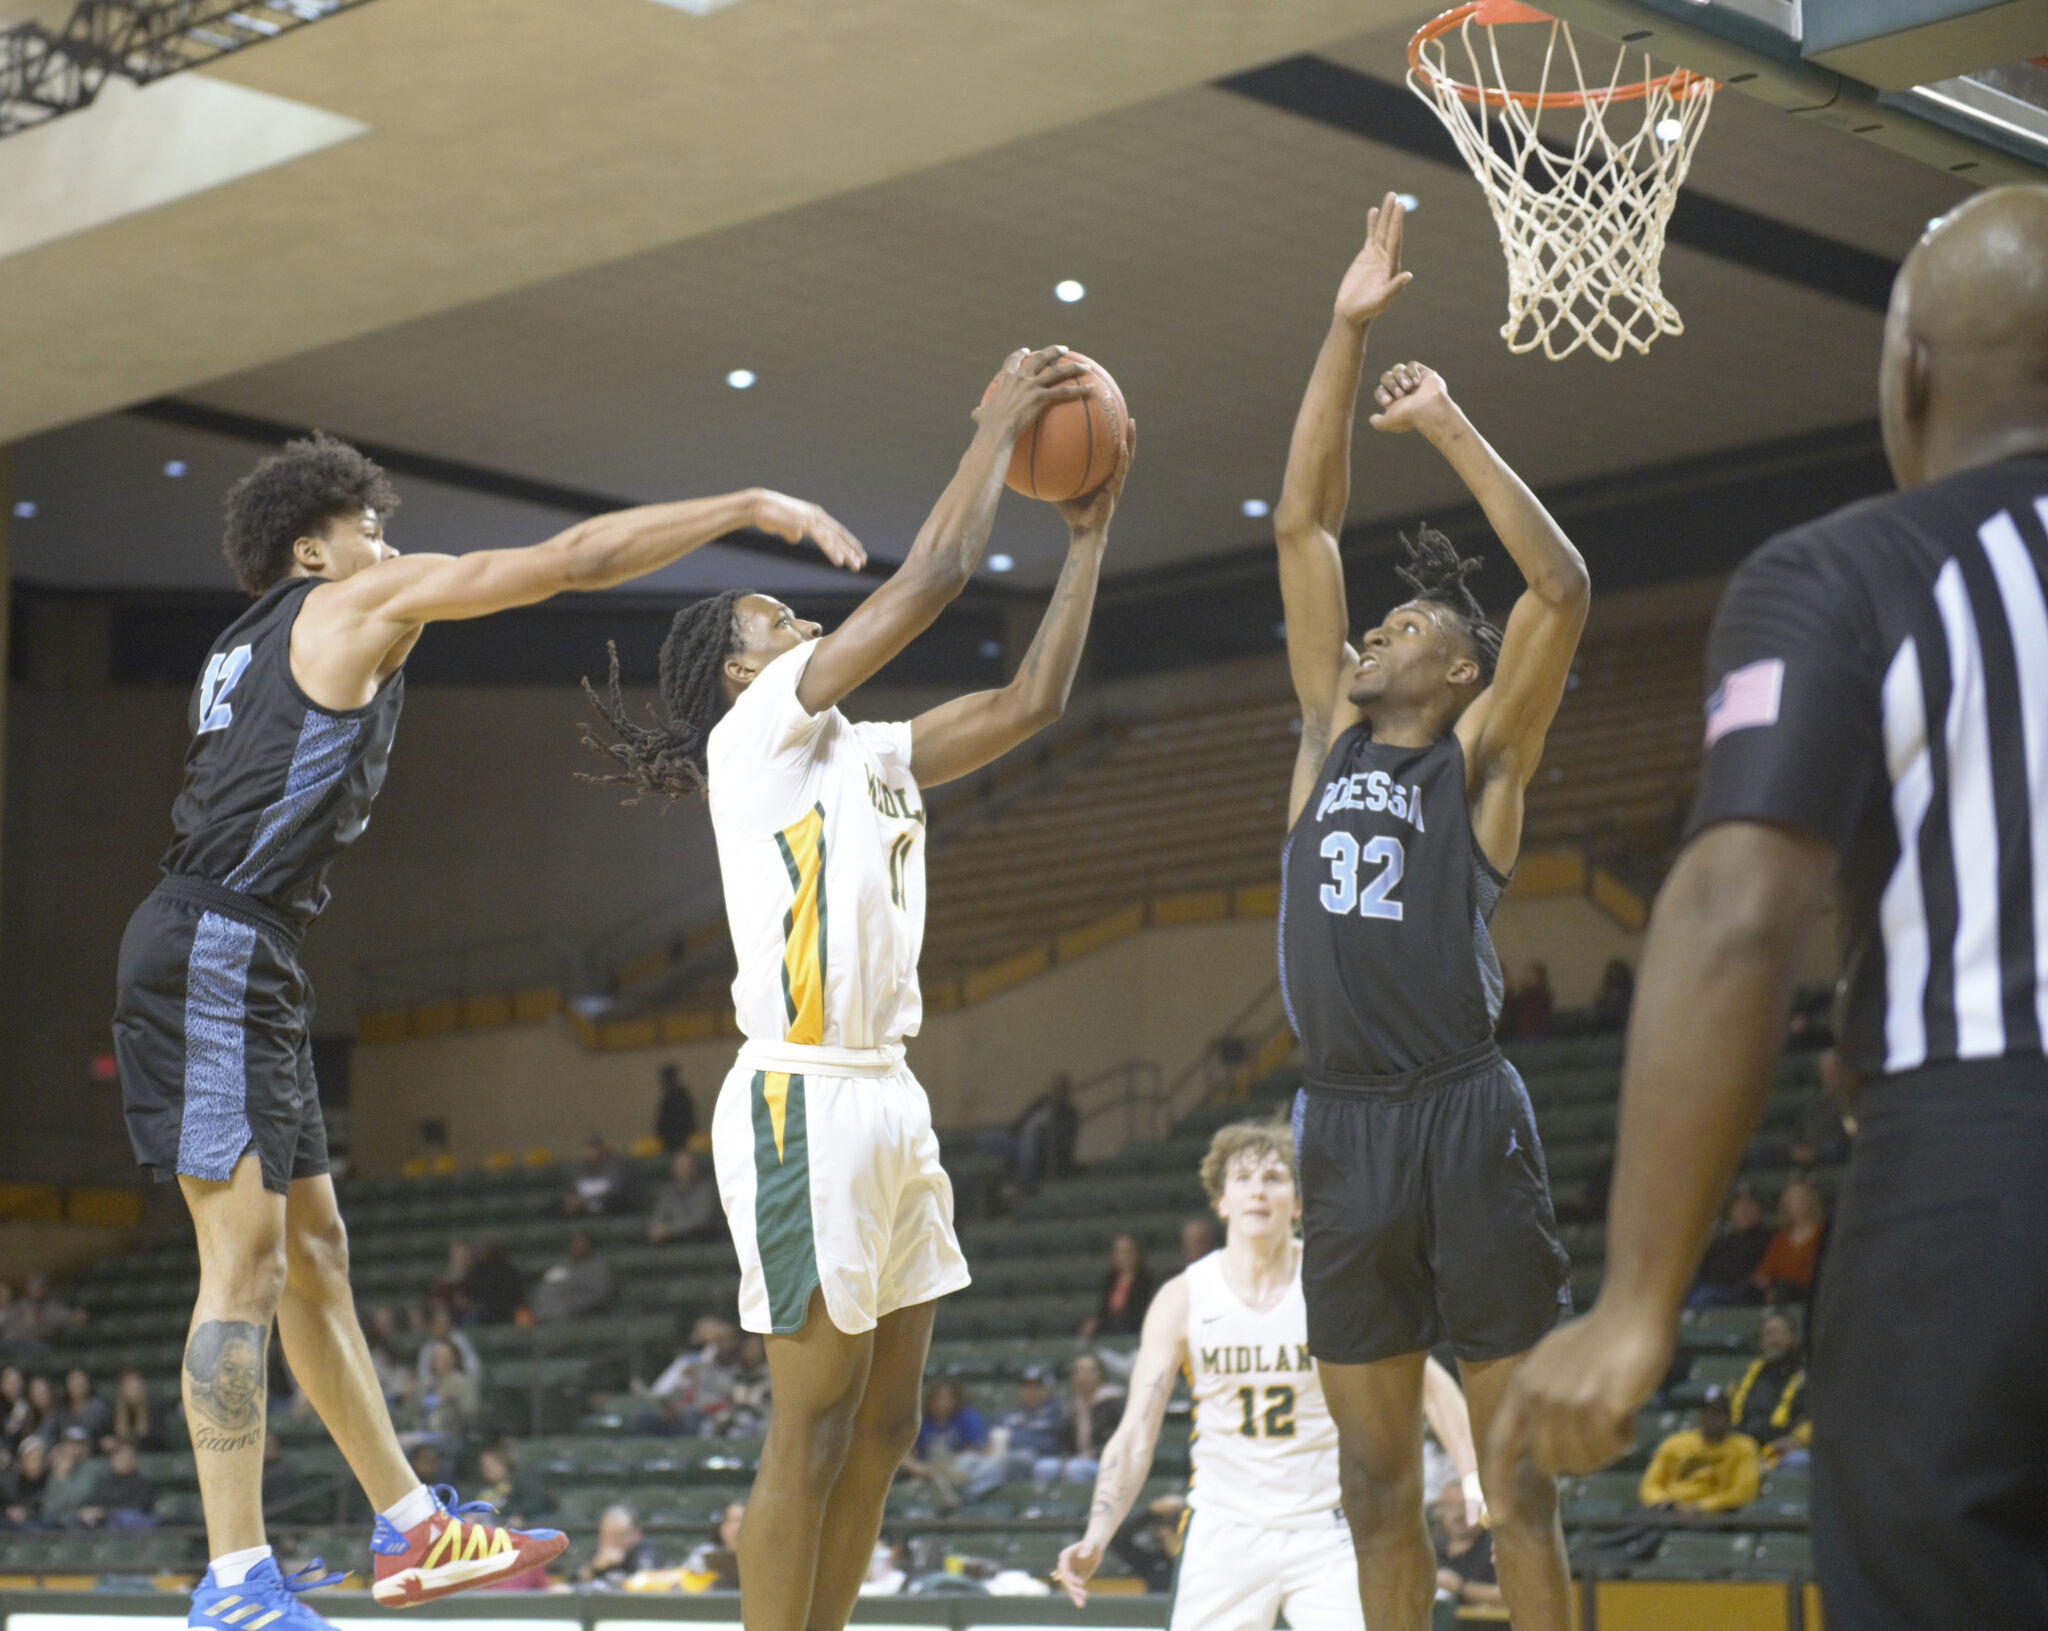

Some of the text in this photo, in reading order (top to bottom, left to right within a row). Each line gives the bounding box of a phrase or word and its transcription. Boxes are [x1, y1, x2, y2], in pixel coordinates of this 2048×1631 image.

[863, 761, 925, 826] MIDL
[1319, 831, 1405, 921] 32
[1238, 1383, 1297, 1439] 12
